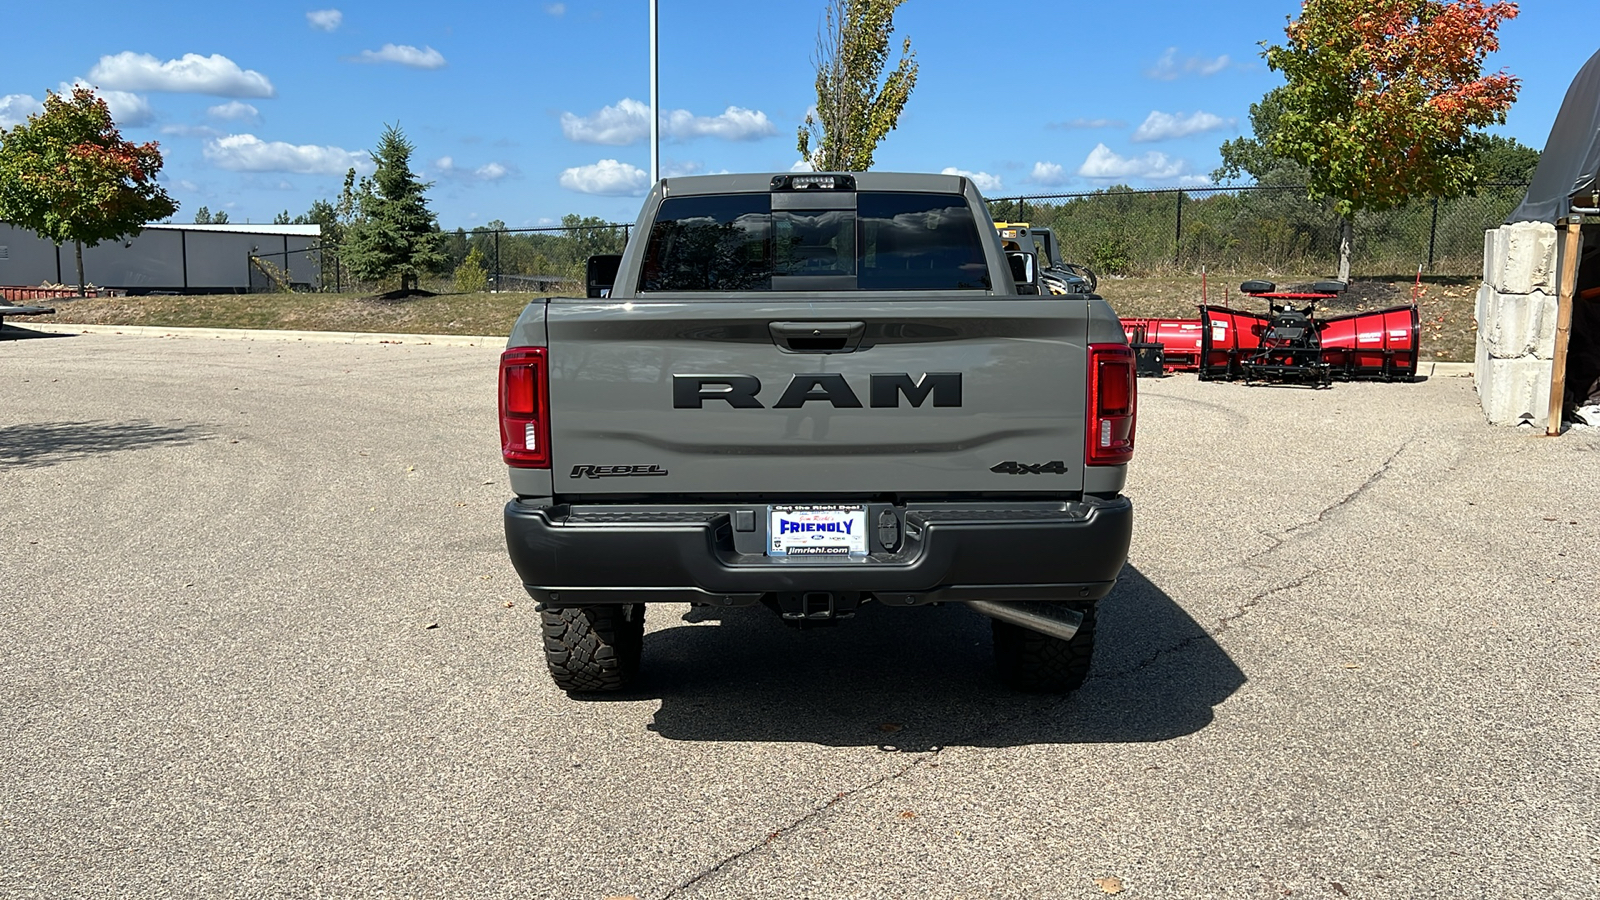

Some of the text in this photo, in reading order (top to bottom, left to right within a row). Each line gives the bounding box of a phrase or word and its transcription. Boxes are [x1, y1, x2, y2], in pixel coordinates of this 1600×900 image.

[672, 372, 963, 409] RAM
[570, 463, 669, 479] REBEL
[989, 460, 1068, 475] 4x4
[780, 518, 854, 535] FRIENDLY
[788, 547, 848, 555] jimriehl.com
